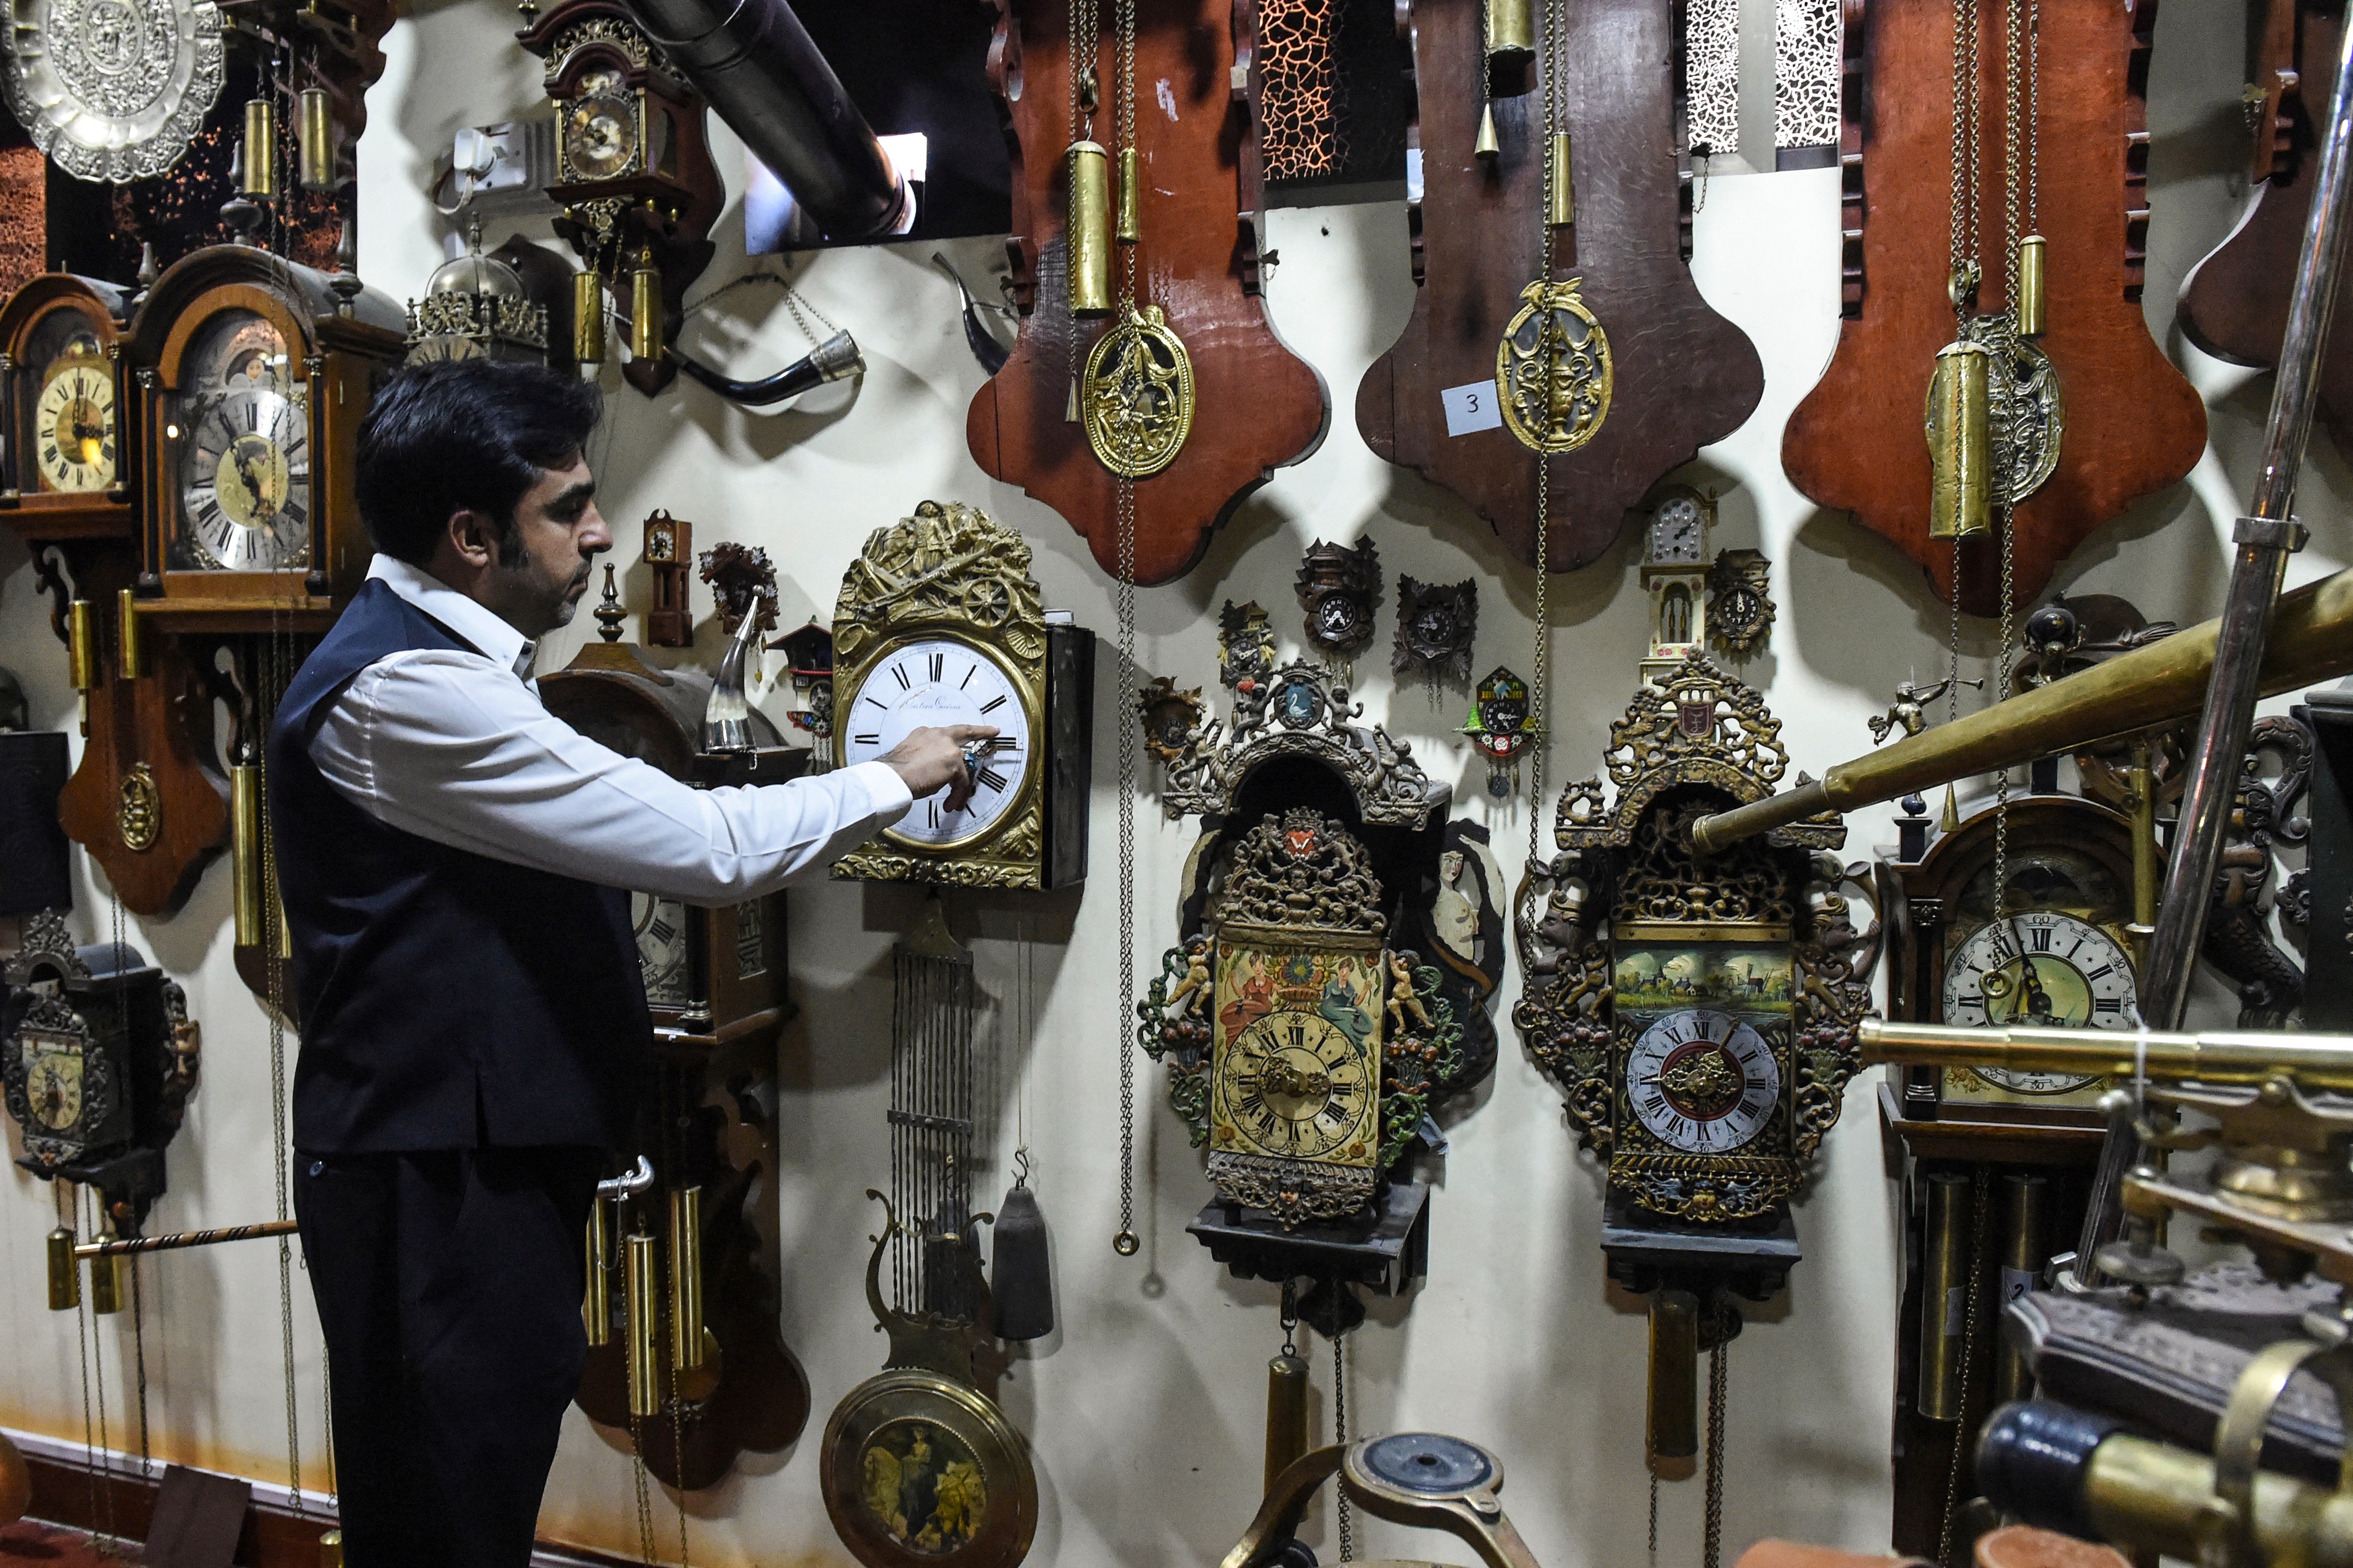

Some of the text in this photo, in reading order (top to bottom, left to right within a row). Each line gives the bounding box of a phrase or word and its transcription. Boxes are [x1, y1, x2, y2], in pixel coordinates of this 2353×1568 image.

[1467, 394, 1478, 413] 3
[891, 662, 911, 691] XI
[928, 653, 944, 683] XII
[960, 664, 977, 691] I
[979, 694, 1007, 715] II
[976, 766, 1009, 795] IIII
[928, 800, 939, 829] VI
[2033, 914, 2050, 924] 60
[2029, 928, 2053, 952] XII
[2063, 937, 2085, 961] I
[2085, 962, 2115, 982] II
[2094, 996, 2121, 1014] III
[1288, 1026, 1305, 1046] XII
[1665, 1027, 1683, 1048] XI
[1693, 1022, 1709, 1040] XII
[1314, 1035, 1327, 1053] I
[1328, 1055, 1348, 1071] II
[1739, 1049, 1760, 1065] II
[1332, 1081, 1352, 1097] III
[1746, 1078, 1766, 1091] III
[1323, 1101, 1348, 1125] IIII
[1644, 1094, 1668, 1120] VIII
[1288, 1122, 1301, 1142] VI
[1665, 1114, 1686, 1137] VII
[1696, 1122, 1711, 1141] VI
[1723, 1117, 1740, 1136] V
